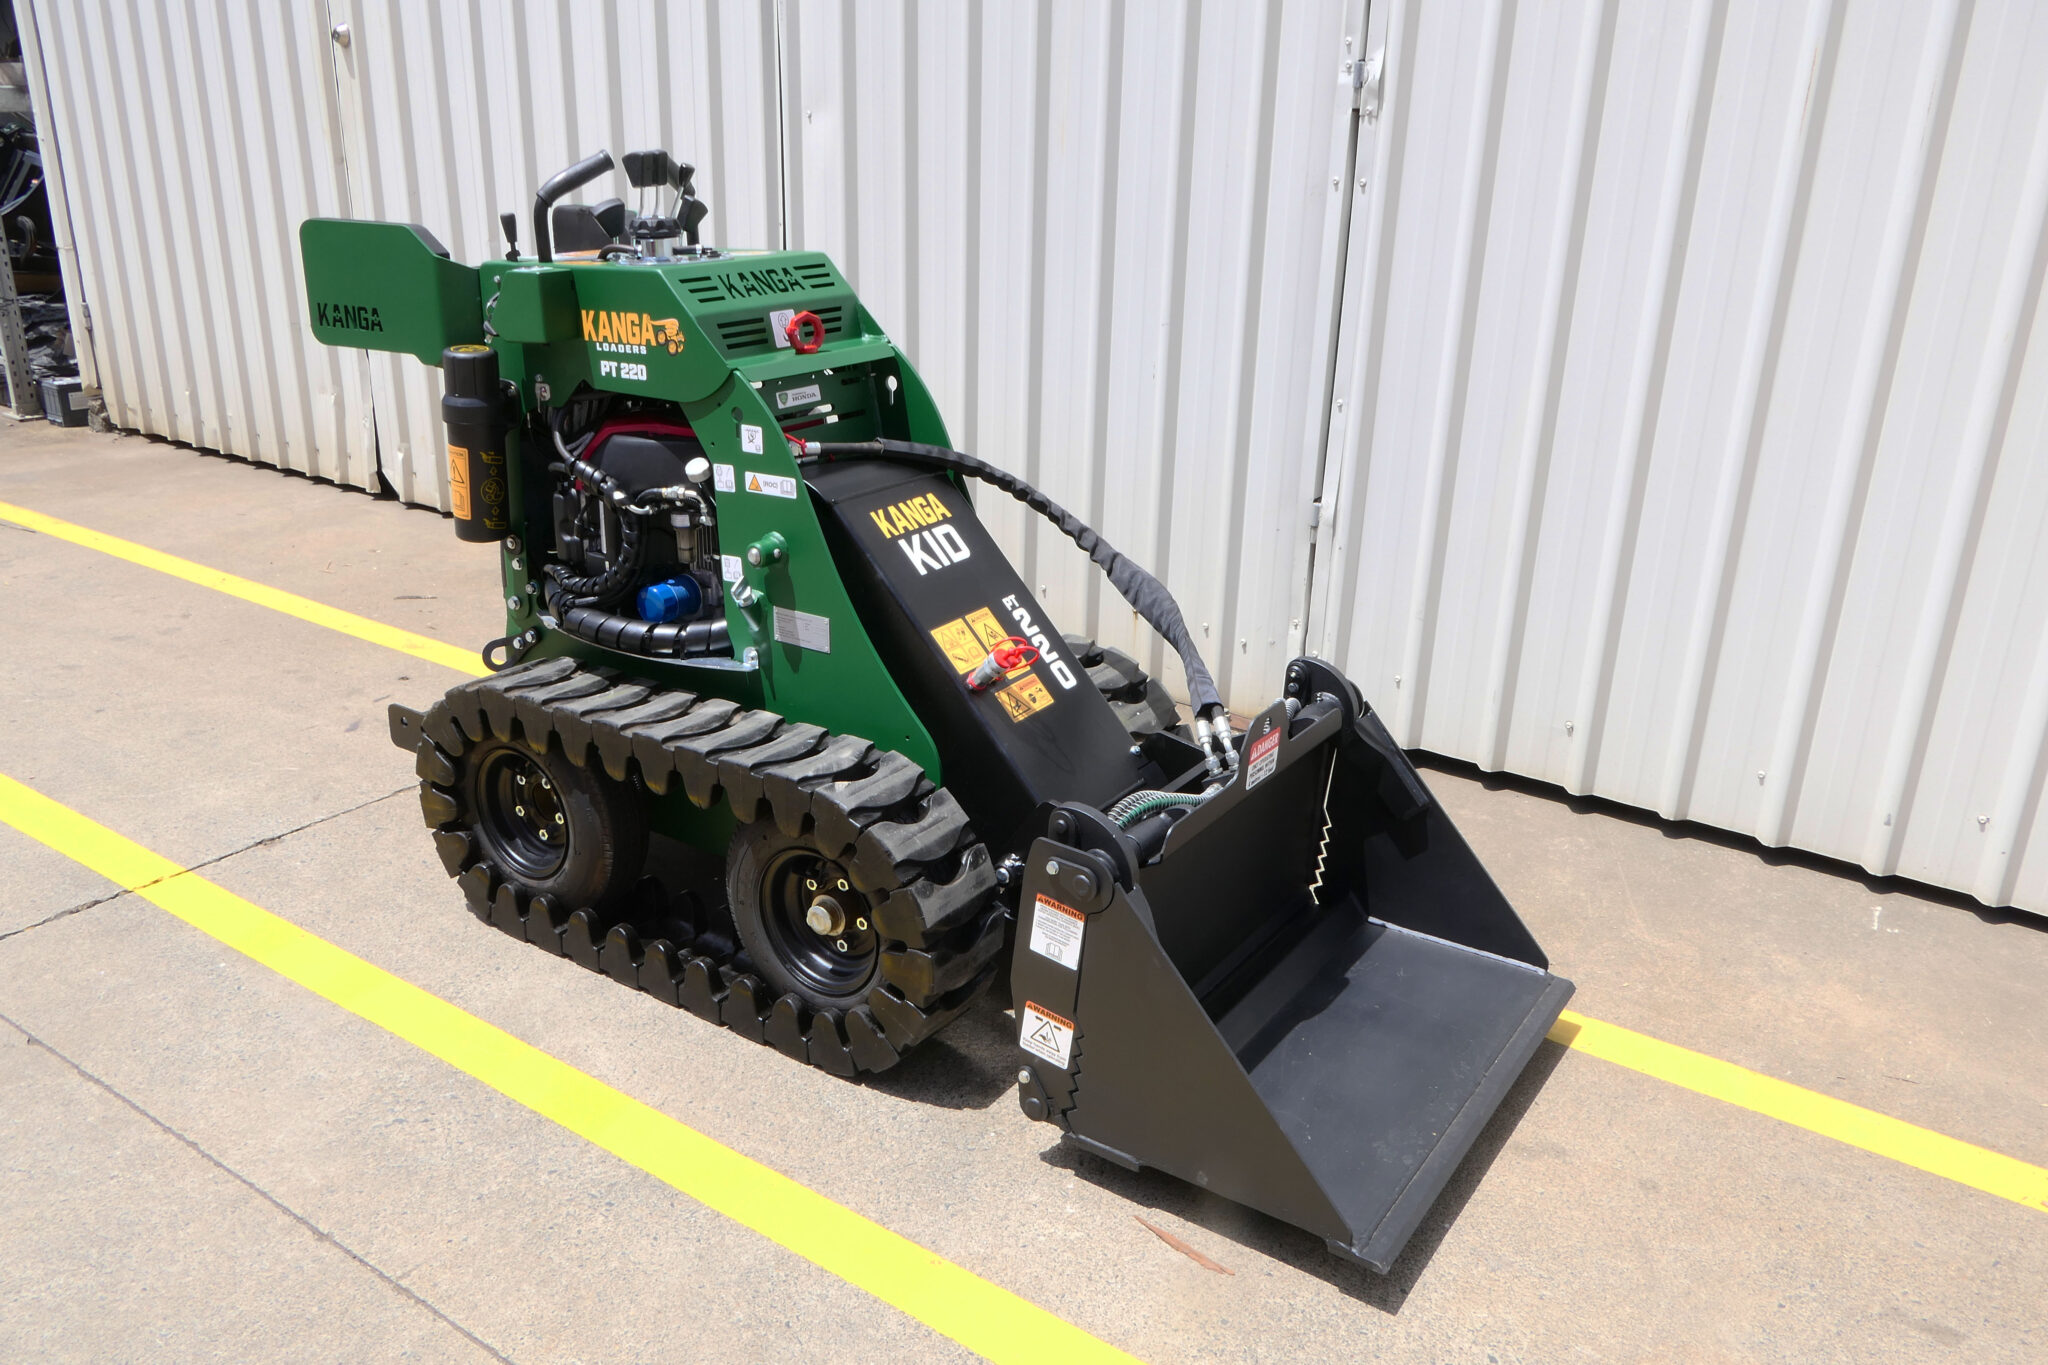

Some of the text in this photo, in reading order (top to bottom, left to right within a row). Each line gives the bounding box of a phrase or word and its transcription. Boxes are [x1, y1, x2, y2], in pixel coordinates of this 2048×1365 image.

[717, 266, 806, 299] KANGA
[316, 302, 384, 332] KANGA
[581, 309, 657, 346] KANGA
[596, 342, 647, 355] LOADERS
[600, 360, 647, 381] PT 220
[869, 492, 953, 539] KANGA
[897, 523, 971, 576] KID
[1001, 594, 1020, 611] PT
[1012, 606, 1078, 690] 220
[1257, 732, 1280, 756] DANGER
[1043, 897, 1083, 920] WARNING
[1033, 1004, 1073, 1029] WARNING
